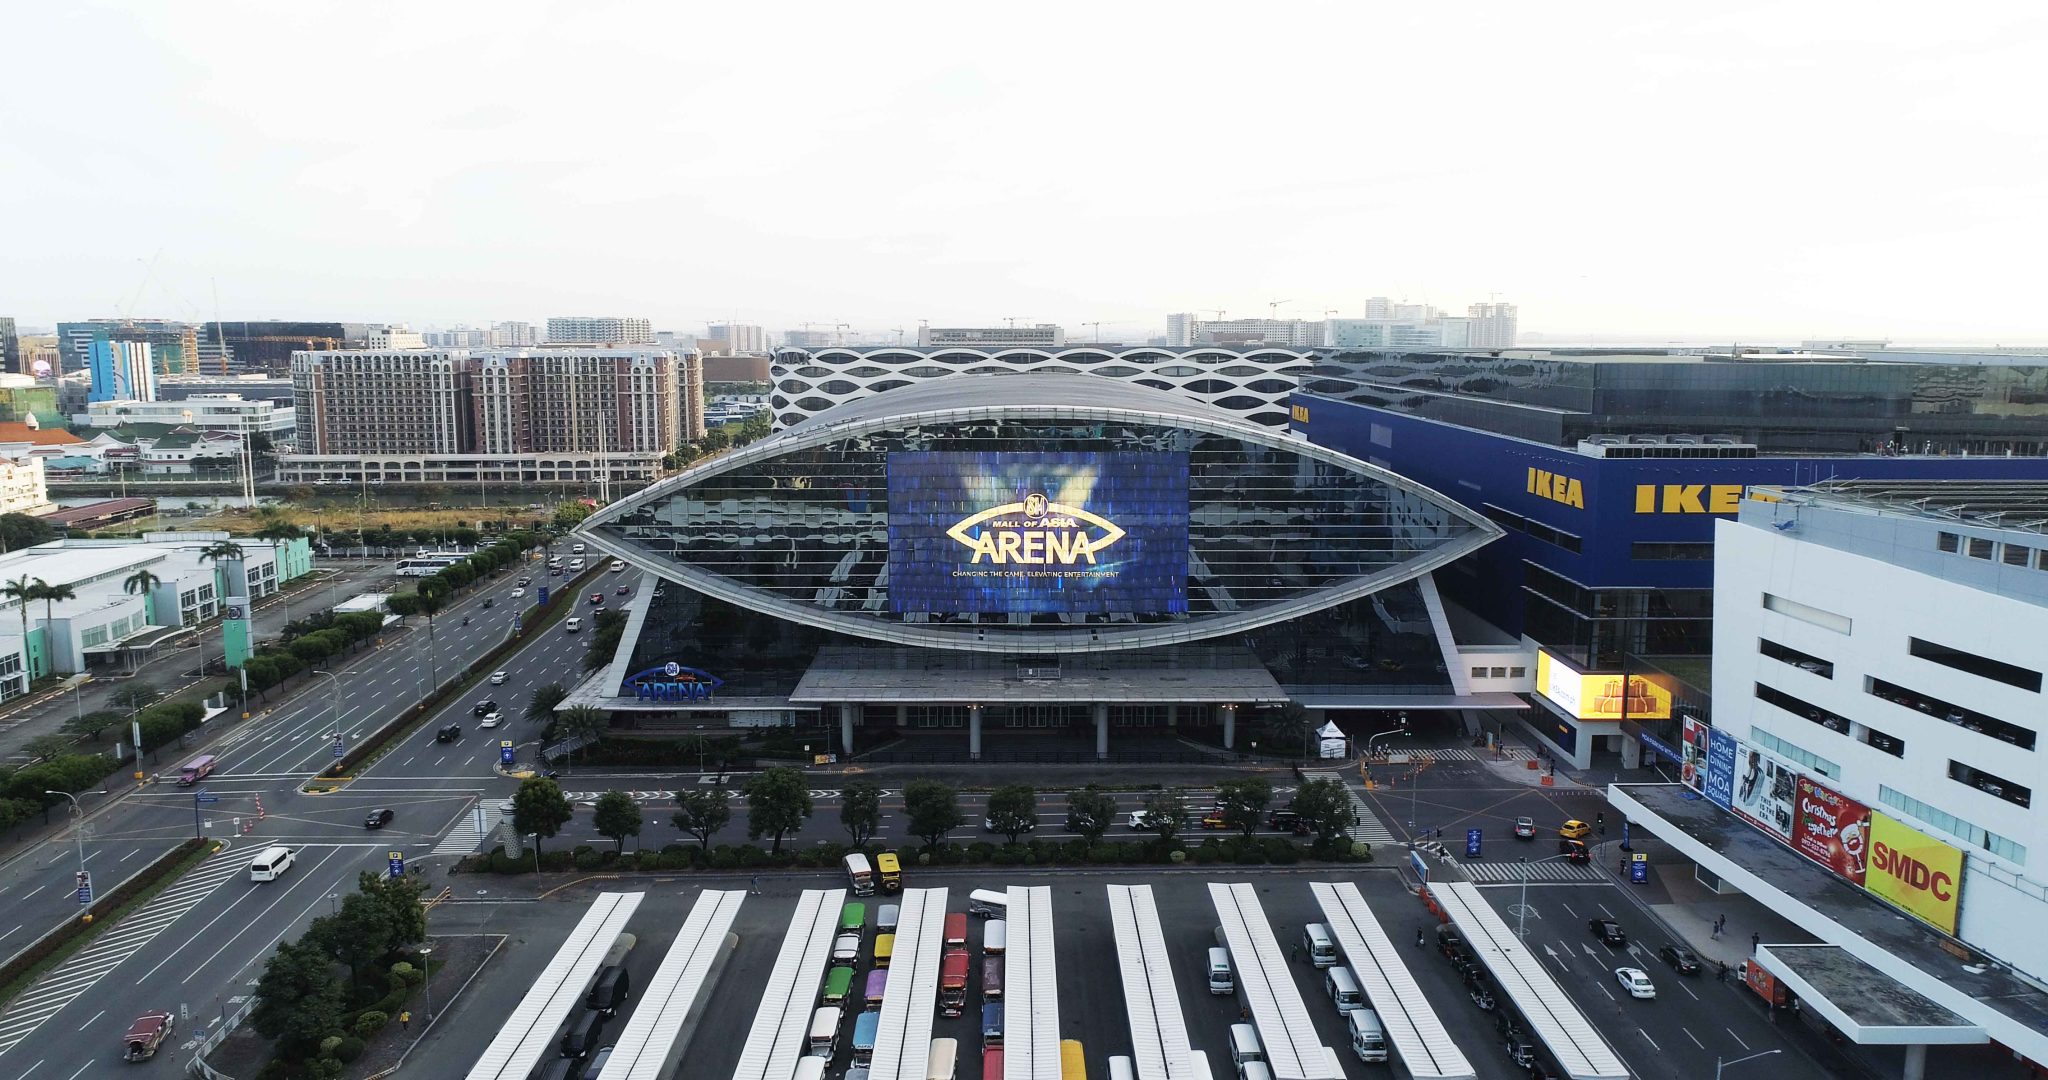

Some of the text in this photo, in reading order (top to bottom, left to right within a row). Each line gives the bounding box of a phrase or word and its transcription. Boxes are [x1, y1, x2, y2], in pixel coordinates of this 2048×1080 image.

[1292, 404, 1309, 423] IKEA
[1527, 467, 1584, 509] IKEA
[992, 517, 1080, 528] MALL OF ASIA
[970, 531, 1096, 564] ARENA
[952, 571, 988, 579] CHANGING
[990, 571, 1003, 579] THE
[1027, 571, 1062, 579] ELEVATING
[1063, 571, 1120, 579] ENTERTAINMENT
[638, 682, 709, 702] ARENA
[1710, 738, 1734, 759] HOME
[1709, 755, 1732, 775] DINING
[1708, 770, 1730, 796] MOA
[1707, 785, 1730, 805] SQUARE
[1760, 795, 1772, 806] THIS
[1766, 806, 1775, 817] THE
[1802, 797, 1836, 826] Christmas
[1872, 841, 1952, 902] SMDC
